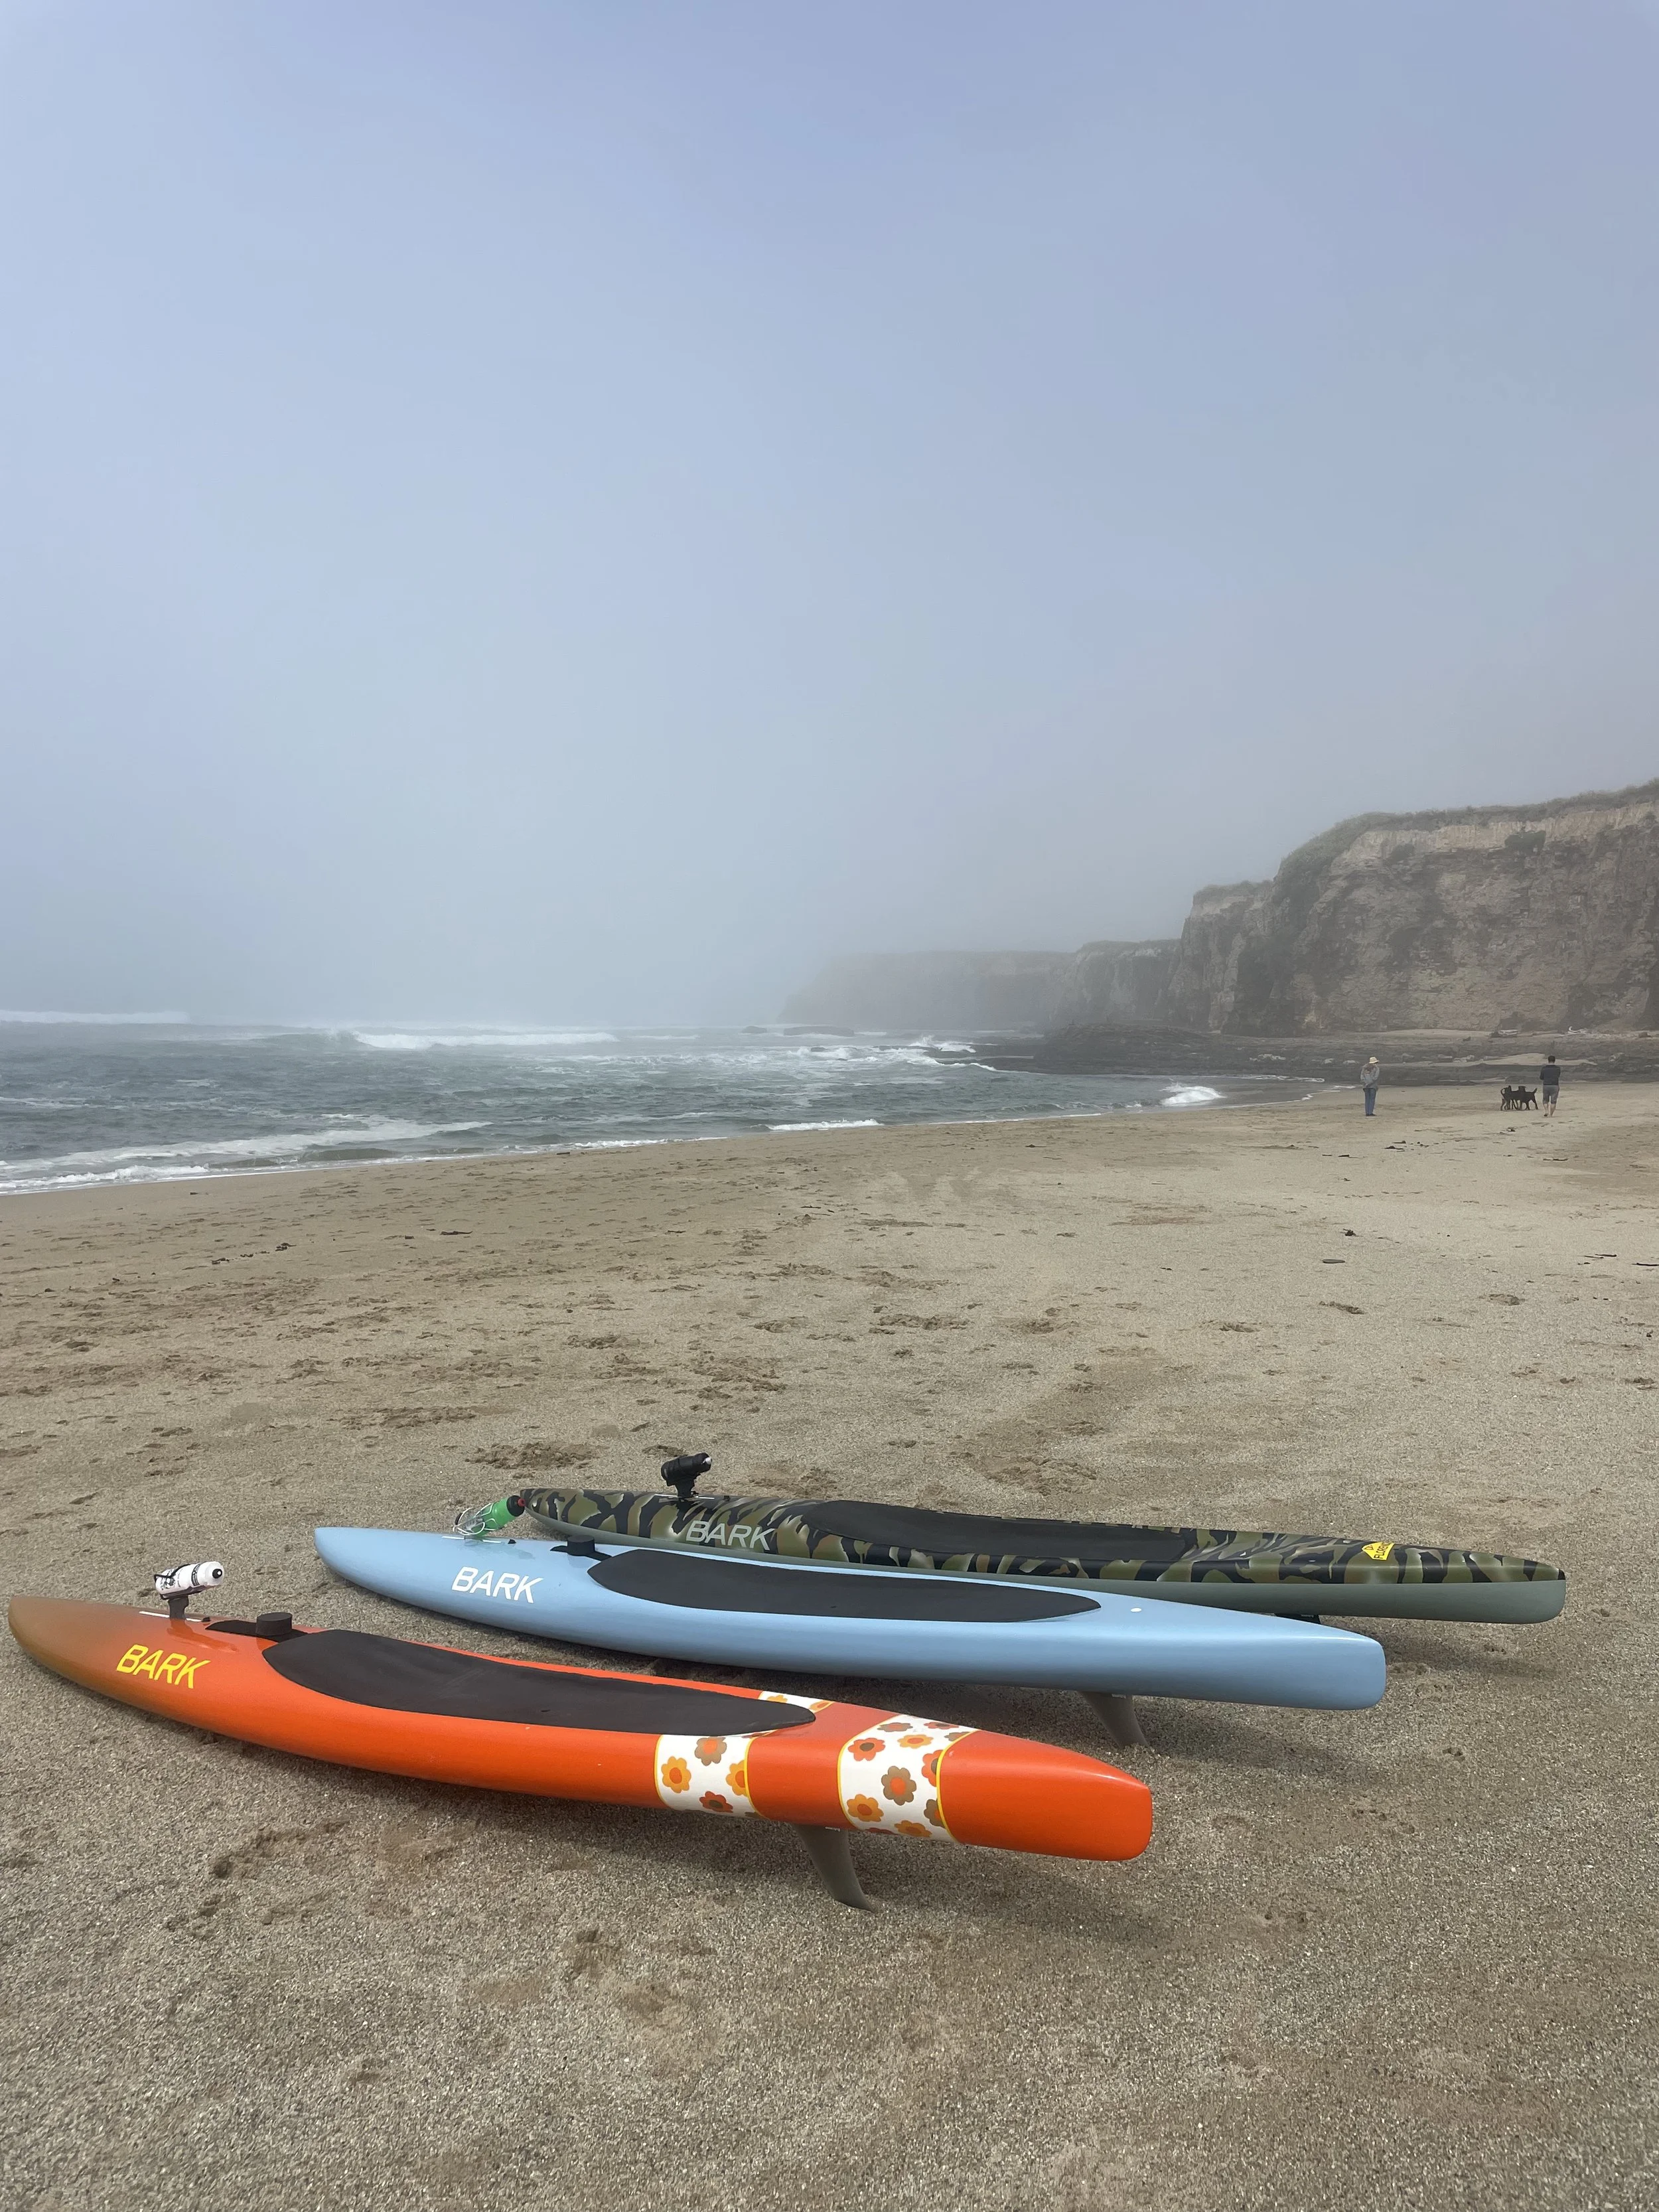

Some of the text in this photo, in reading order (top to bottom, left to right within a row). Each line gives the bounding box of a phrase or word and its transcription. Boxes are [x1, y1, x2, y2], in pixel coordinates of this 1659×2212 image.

[686, 1520, 775, 1550] BARK
[452, 1566, 543, 1603] BARK
[116, 1644, 211, 1689] BARK
